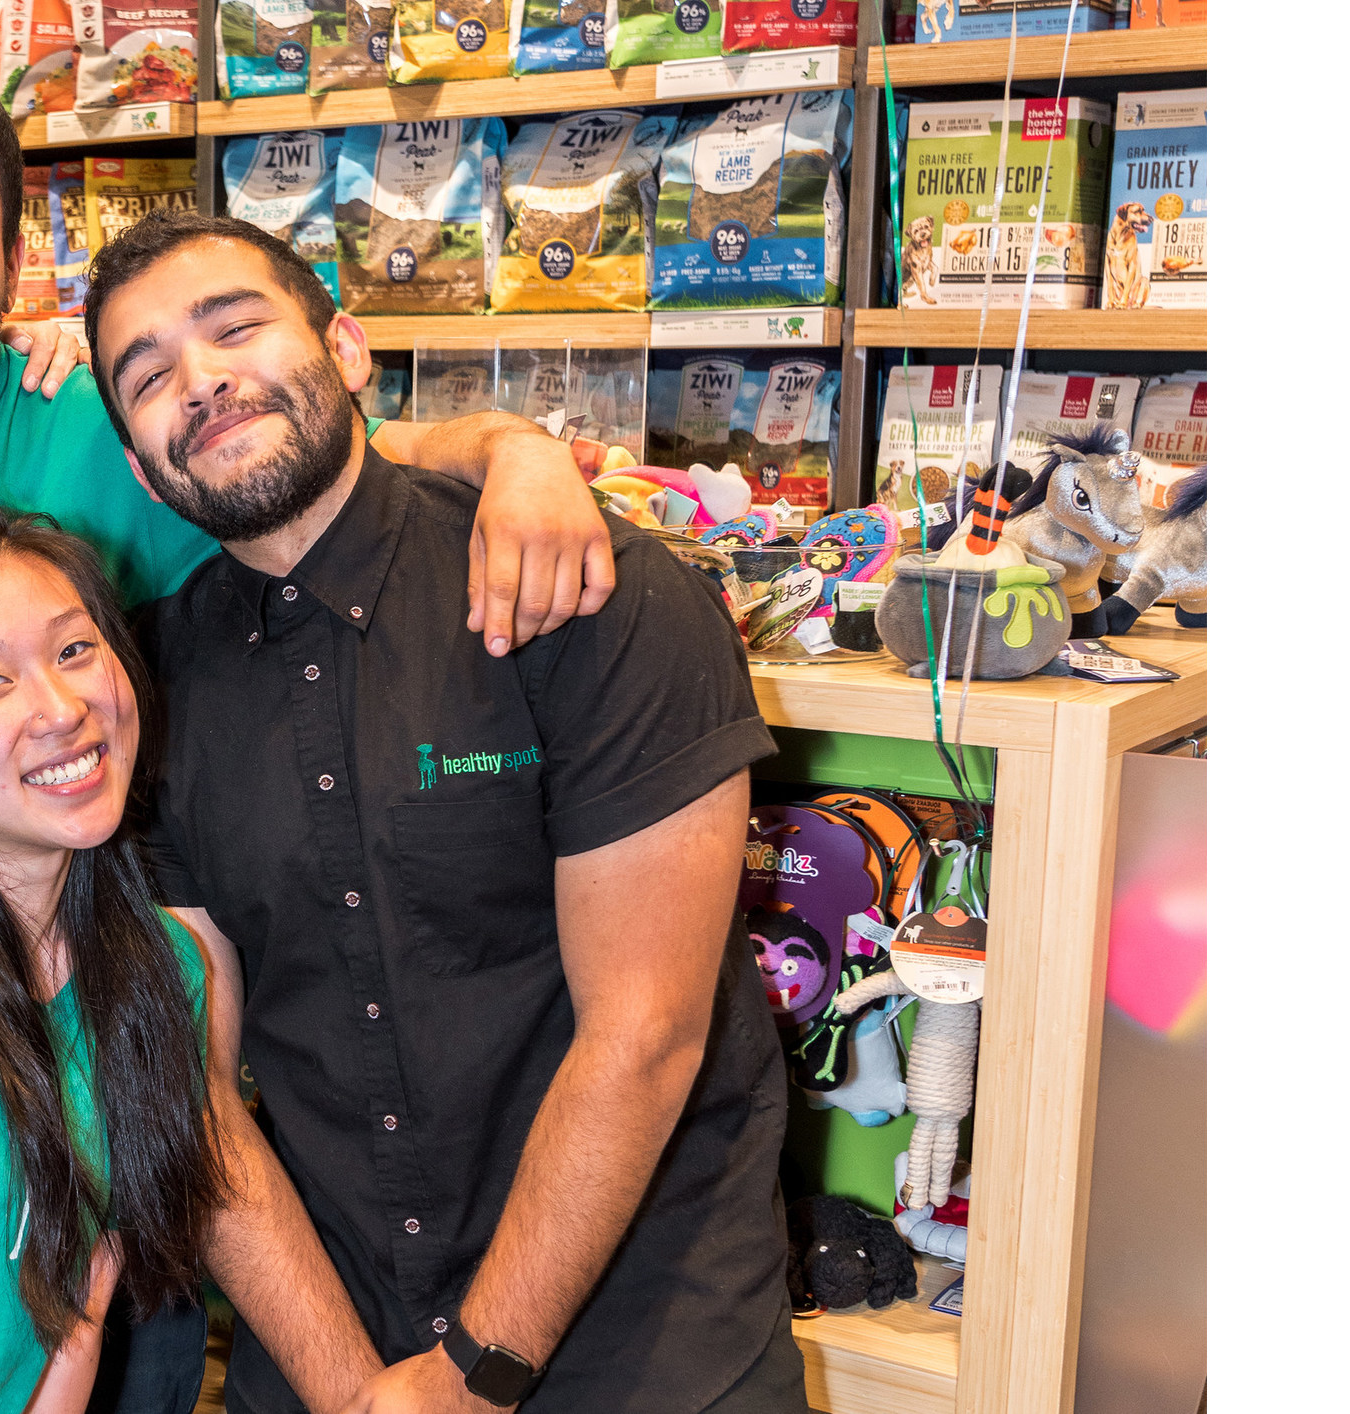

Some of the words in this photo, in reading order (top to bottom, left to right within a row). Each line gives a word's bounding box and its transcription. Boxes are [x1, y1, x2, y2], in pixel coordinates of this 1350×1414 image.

[116, 10, 146, 20] BEEF
[148, 9, 190, 19] RECIPE
[288, 2, 307, 14] RECI
[680, 5, 707, 17] 96%
[36, 24, 74, 36] SALMO
[459, 25, 485, 38] 96%
[585, 20, 604, 33] 96
[371, 37, 388, 49] 96
[278, 47, 303, 60] 96%
[726, 108, 765, 124] Peak
[1028, 109, 1044, 119] the
[395, 118, 450, 143] ZIWI
[1027, 119, 1062, 127] honest
[560, 126, 624, 148] ZIWI
[1026, 126, 1062, 137] kitchen
[265, 144, 312, 168] ZIWI
[1126, 146, 1159, 159] GRAIN
[1162, 144, 1189, 157] FREE
[720, 155, 751, 170] LAMB
[918, 154, 948, 166] GRAIN
[950, 153, 974, 165] FREE
[714, 168, 754, 183] RECIPE
[917, 167, 987, 196] CHICKEN
[994, 166, 1054, 194] ECIPE
[1126, 160, 1199, 191] TURKEY
[113, 190, 198, 214] PRIMAL
[1023, 226, 1046, 237] SWT
[1165, 223, 1179, 244] 18
[1186, 222, 1205, 233] CAGE
[716, 229, 746, 245] 96%
[1186, 233, 1205, 244] FREE
[390, 251, 415, 268] 96%
[543, 247, 572, 263] 96%
[1006, 246, 1022, 272] 15
[690, 372, 734, 390] ZIWI
[775, 375, 814, 393] ZIWI
[916, 411, 941, 424] GRAIN
[943, 411, 963, 423] FREE
[944, 423, 984, 443] RECPE
[1174, 419, 1203, 433] GRAIN
[1016, 430, 1047, 449] CHIC
[1143, 431, 1187, 452] BEEF
[1142, 450, 1163, 460] TASTY
[1165, 453, 1189, 462] WHOLE
[762, 464, 779, 478] 96%
